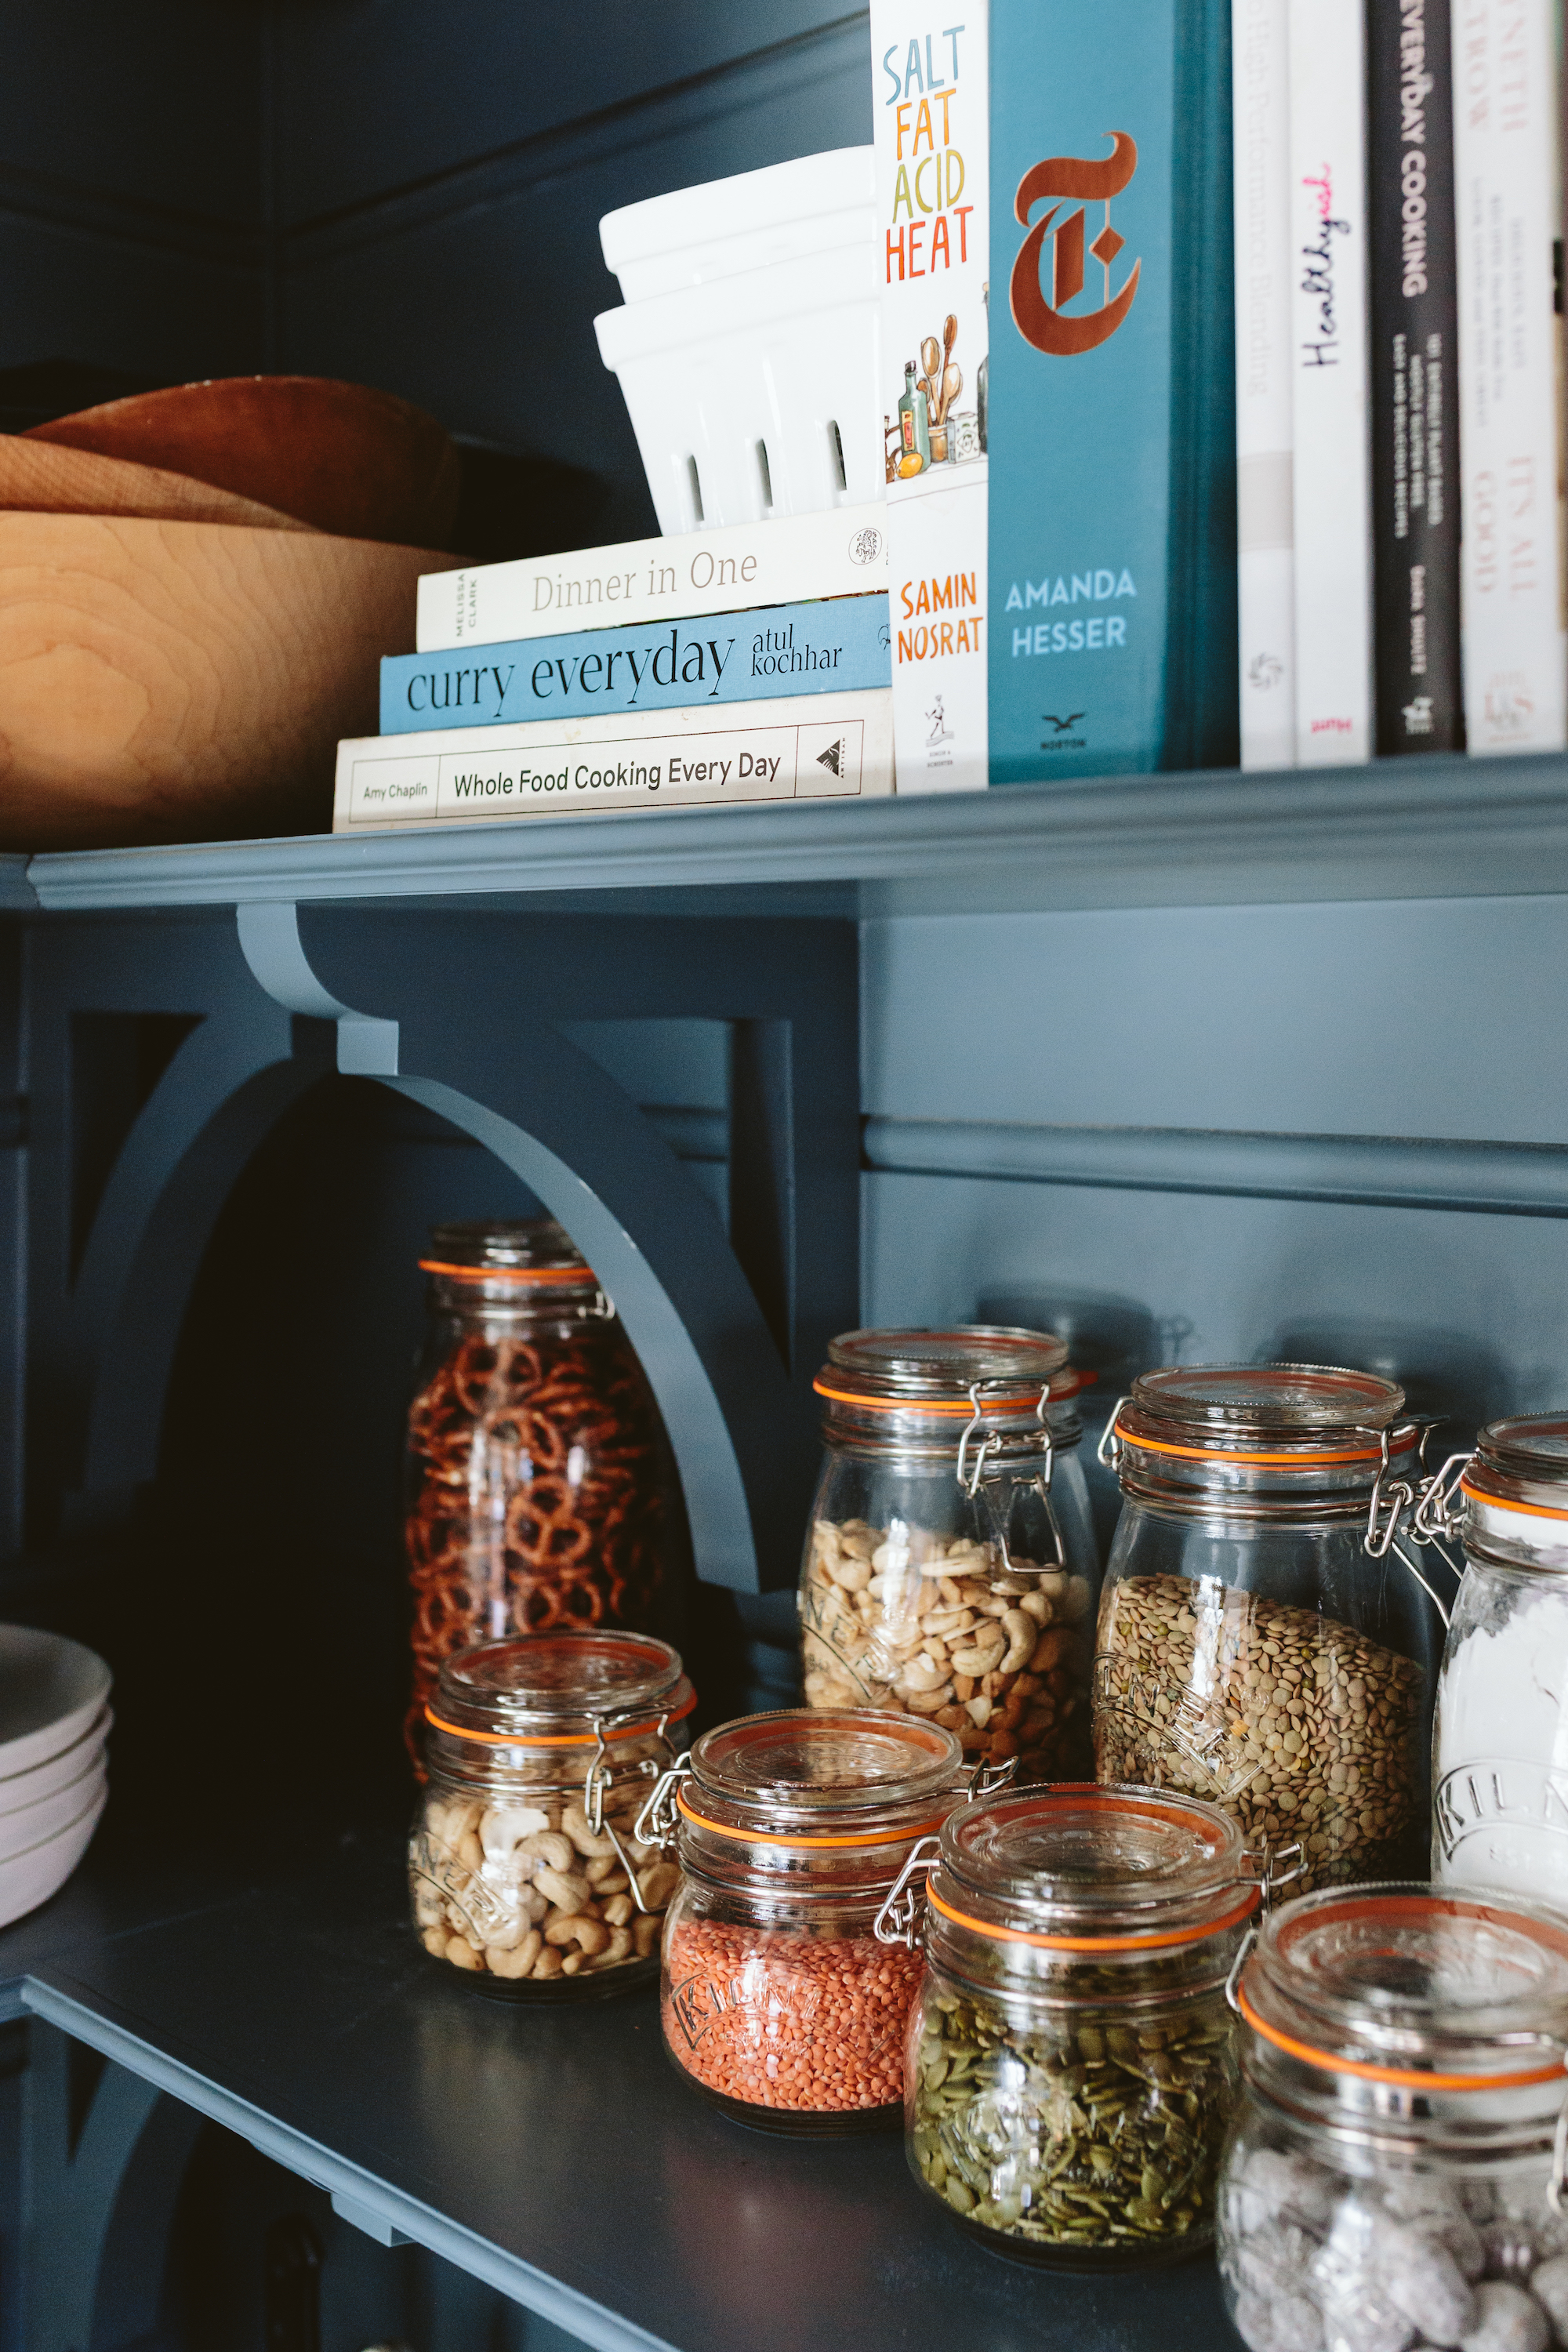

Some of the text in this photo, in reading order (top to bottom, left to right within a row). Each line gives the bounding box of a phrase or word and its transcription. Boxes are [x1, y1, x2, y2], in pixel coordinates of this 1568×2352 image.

[883, 25, 965, 106] SALT
[896, 88, 956, 161] FAT
[892, 149, 965, 224] ACID
[886, 206, 974, 284] HEAT
[1401, 150, 1428, 299] COOKING
[1303, 161, 1351, 367] Healthyish
[456, 573, 466, 637] MELISSA
[468, 579, 478, 629] CLARK
[532, 551, 757, 612] Dinner in One
[900, 572, 977, 620] SAMIN
[1004, 568, 1137, 612] AMANDA
[750, 644, 843, 677] kochhar
[752, 623, 793, 654] atul
[898, 617, 983, 664] NOSRAT
[1011, 615, 1127, 659] HESSER
[407, 629, 735, 717] curry everyday
[1040, 738, 1087, 750] NORTON
[363, 782, 428, 802] Amy Chaplin
[454, 752, 782, 797] Whole Food Cooking Every Day
